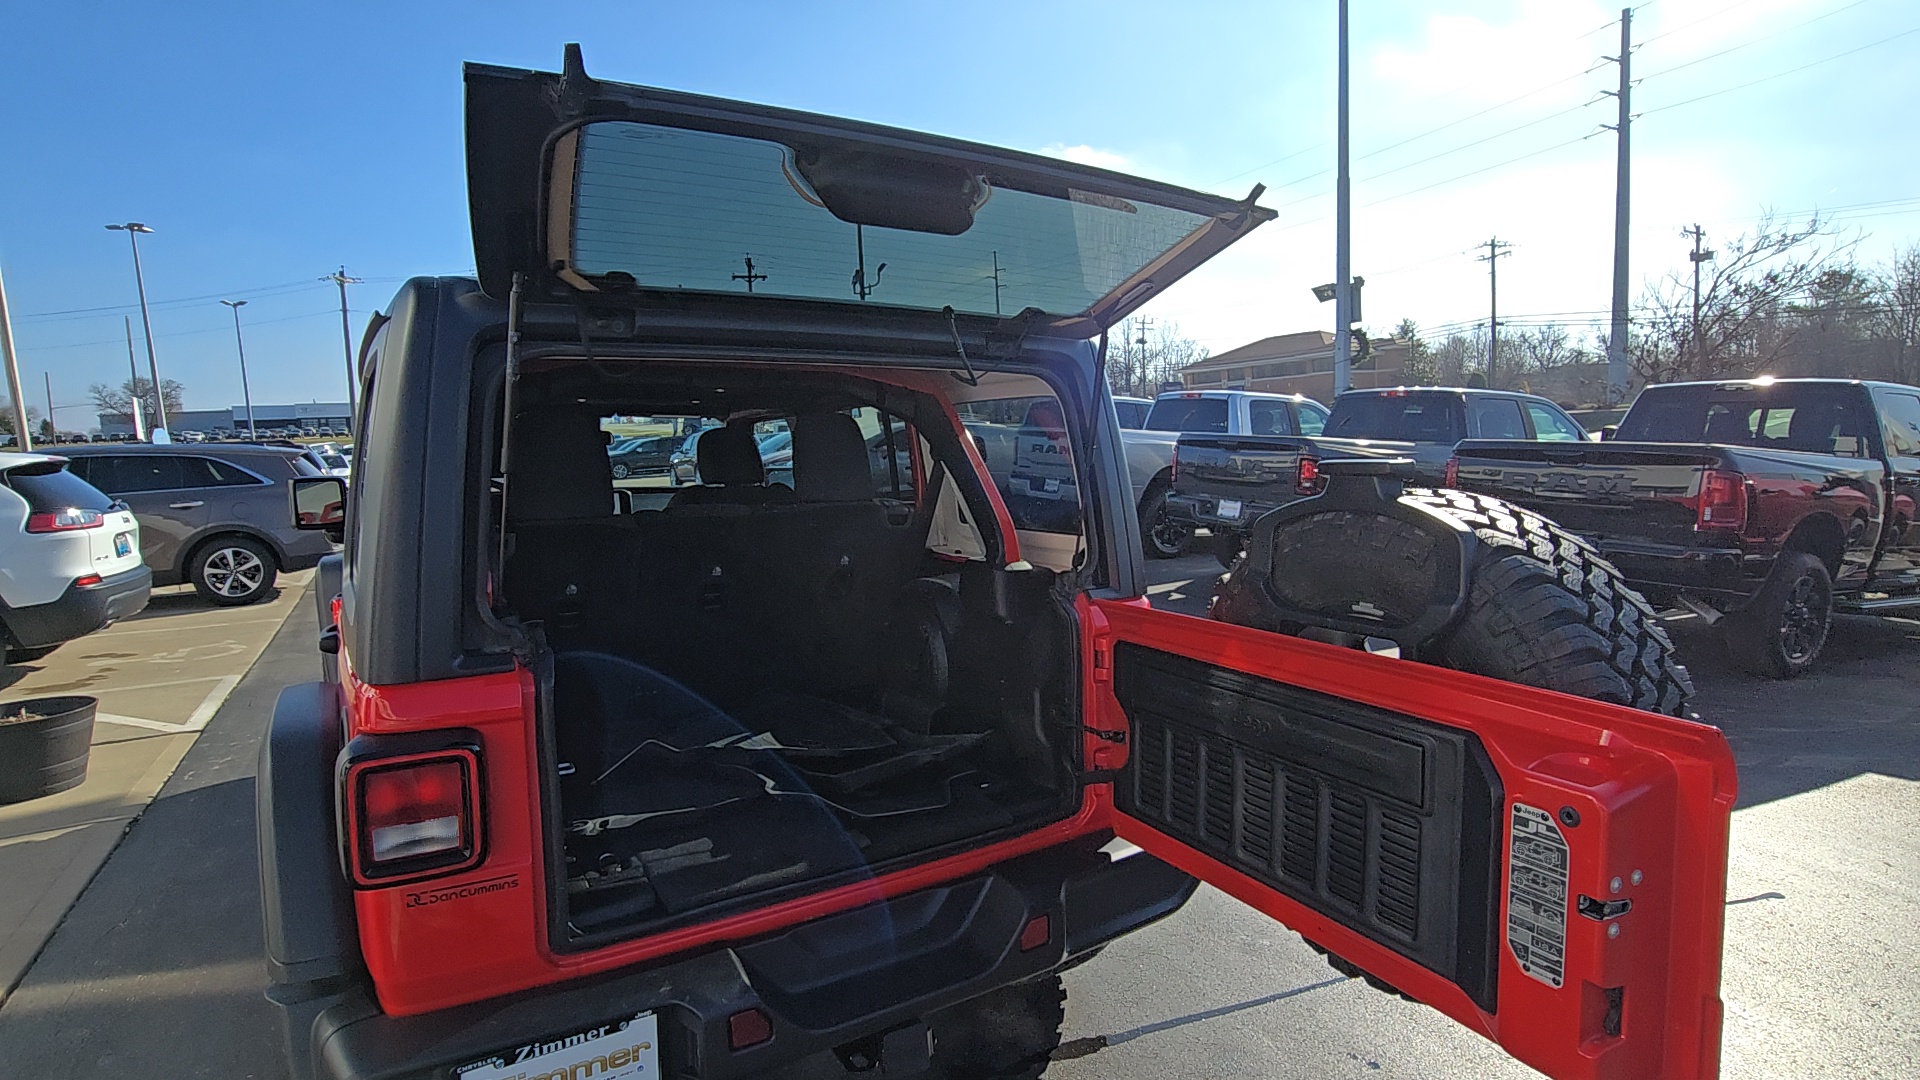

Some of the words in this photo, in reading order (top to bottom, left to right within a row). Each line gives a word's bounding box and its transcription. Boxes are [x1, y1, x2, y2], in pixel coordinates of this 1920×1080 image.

[1032, 443, 1068, 455] RAM
[1203, 456, 1265, 475] RAM
[1502, 471, 1634, 494] RAM
[1522, 807, 1541, 819] Jeep
[1514, 820, 1560, 840] JL
[1533, 940, 1562, 957] USA
[514, 1024, 611, 1064] Zimmer
[634, 1009, 653, 1019] Jeep
[498, 1041, 652, 1080] mmer
